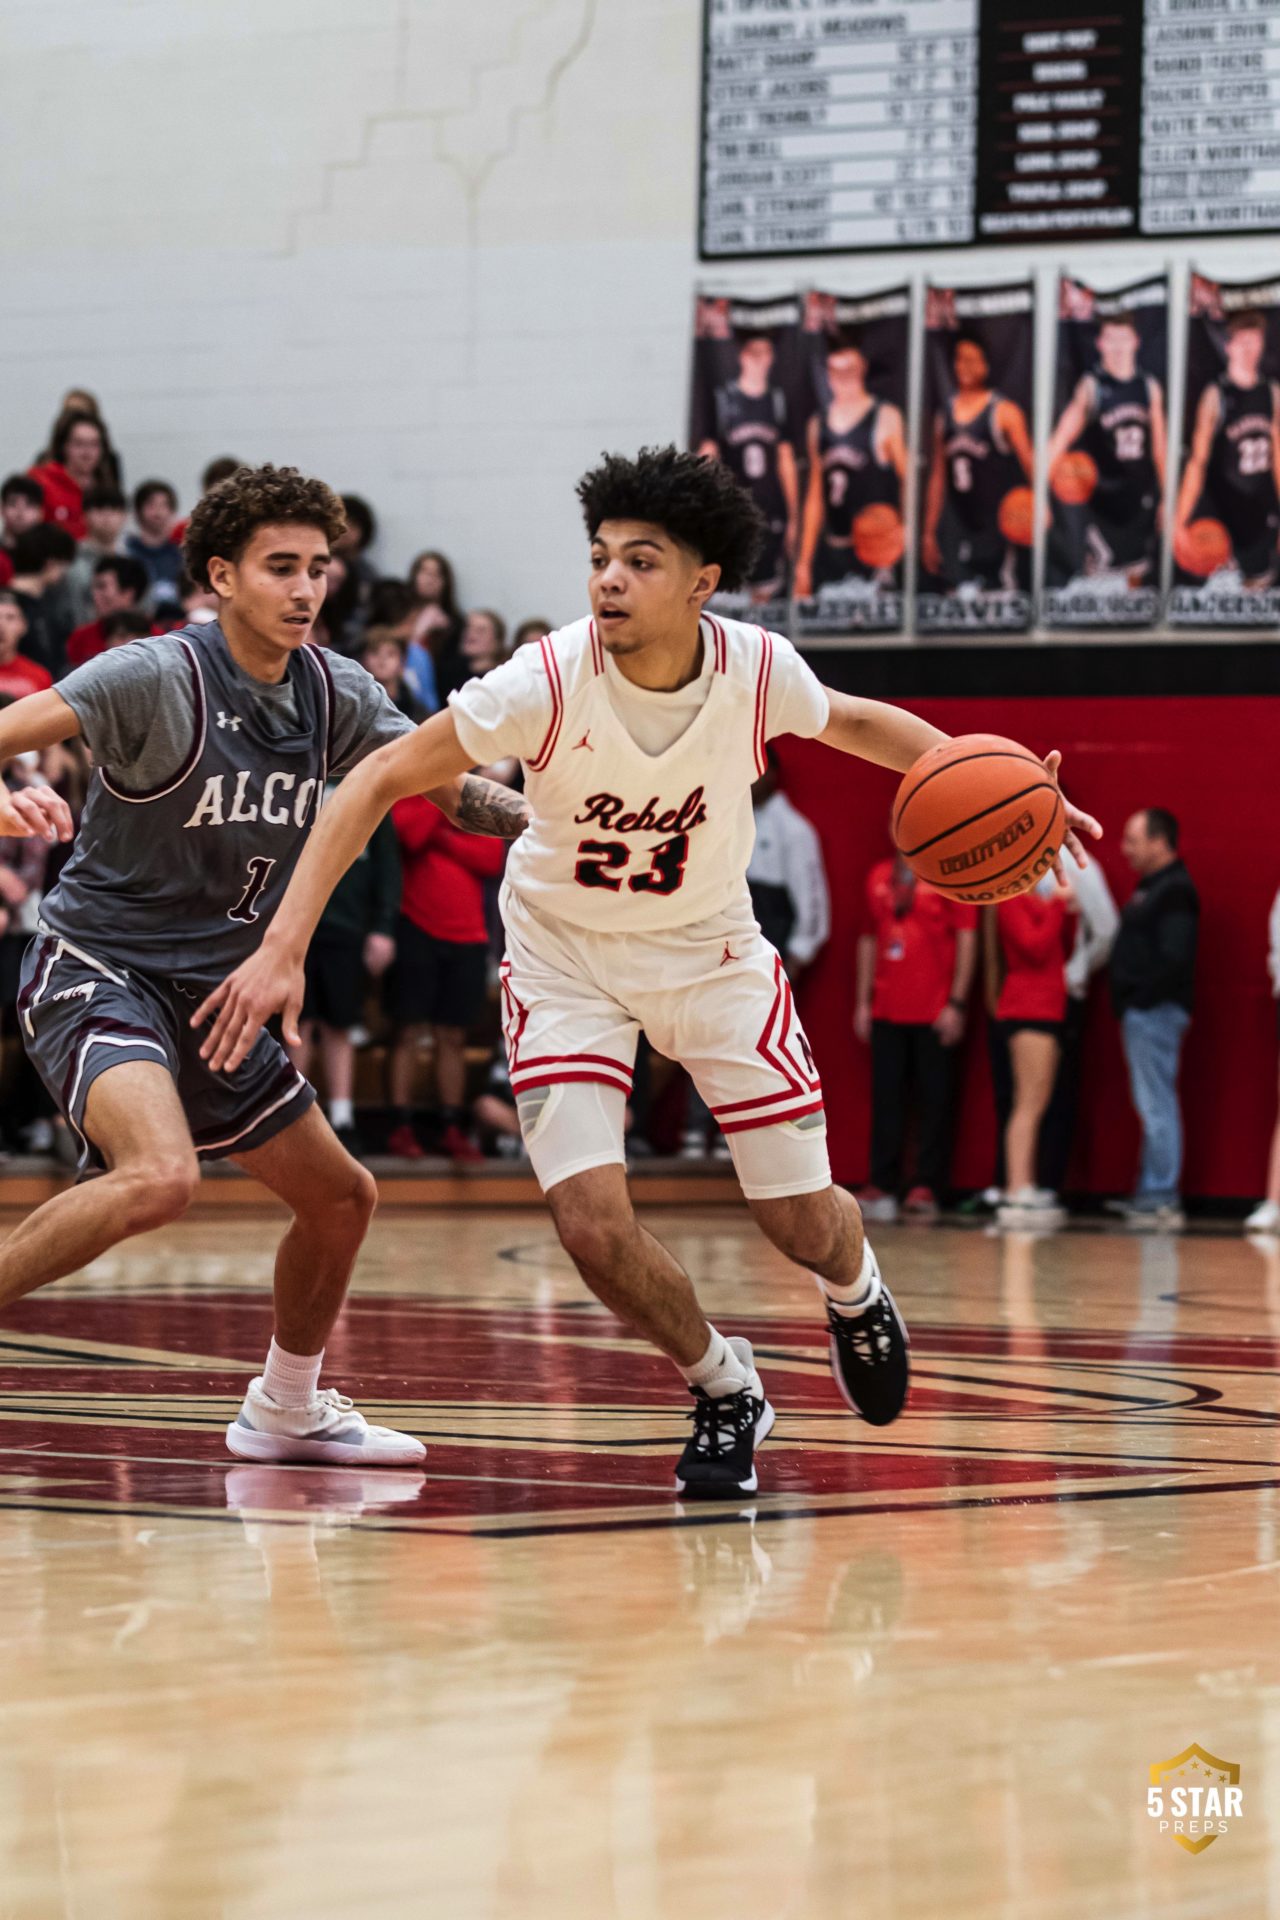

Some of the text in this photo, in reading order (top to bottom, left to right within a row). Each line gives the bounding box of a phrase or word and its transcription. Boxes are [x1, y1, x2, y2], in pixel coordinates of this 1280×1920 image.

[917, 595, 1030, 622] DAVIS
[183, 770, 323, 829] ALCO
[574, 785, 707, 833] Rebels
[574, 831, 690, 896] 23
[938, 809, 1035, 877] EVOLUTION
[227, 856, 278, 923] 1
